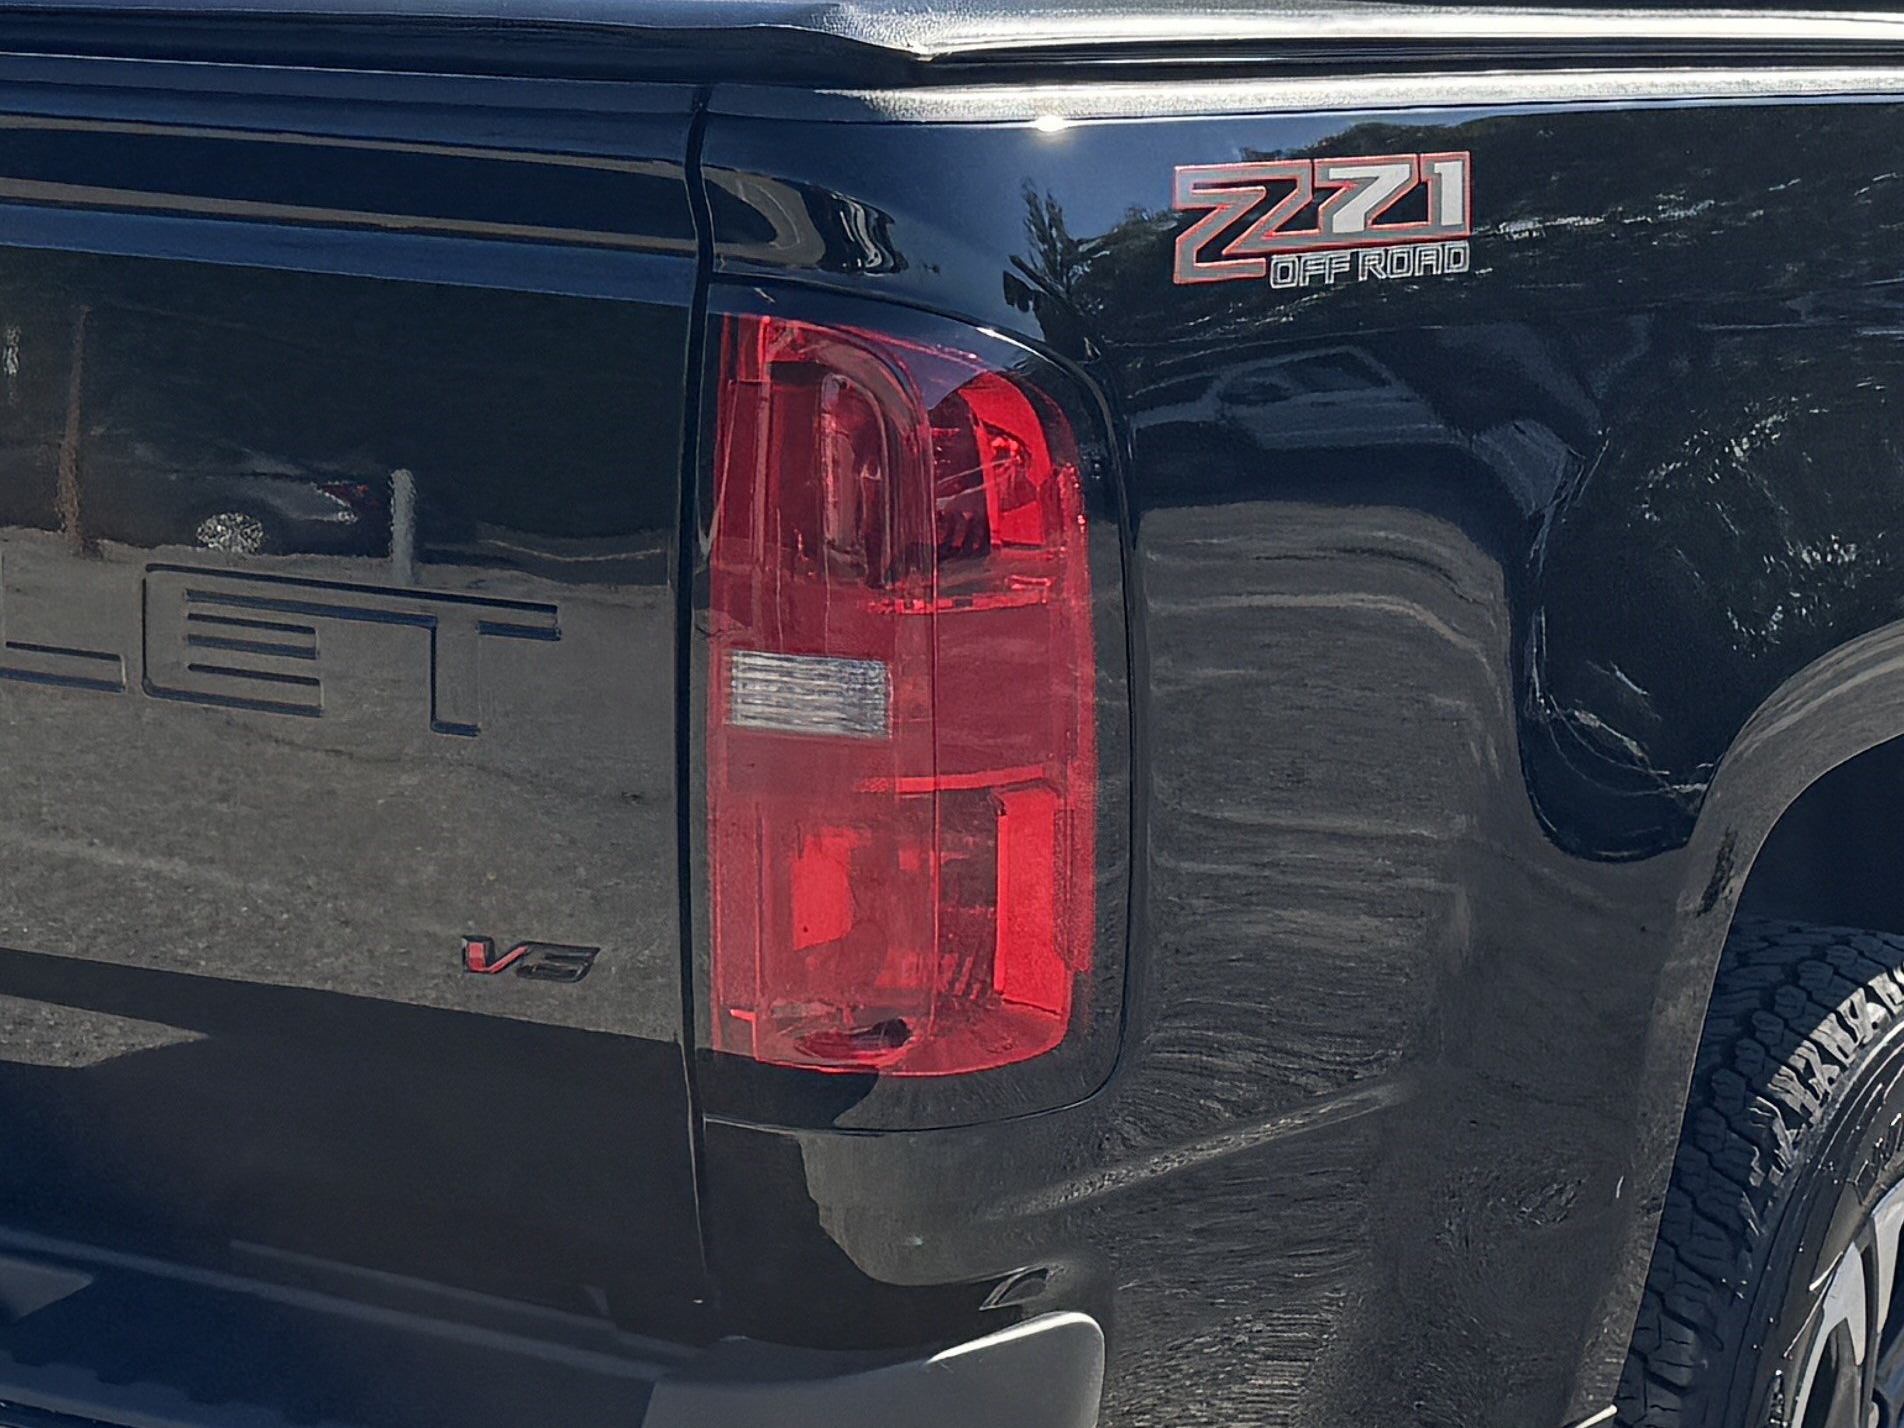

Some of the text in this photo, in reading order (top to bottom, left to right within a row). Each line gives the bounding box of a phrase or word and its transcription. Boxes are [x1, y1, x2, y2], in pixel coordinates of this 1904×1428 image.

[1173, 151, 1472, 285] Z71
[1269, 240, 1472, 289] OFF ROAD
[460, 932, 601, 984] V6
